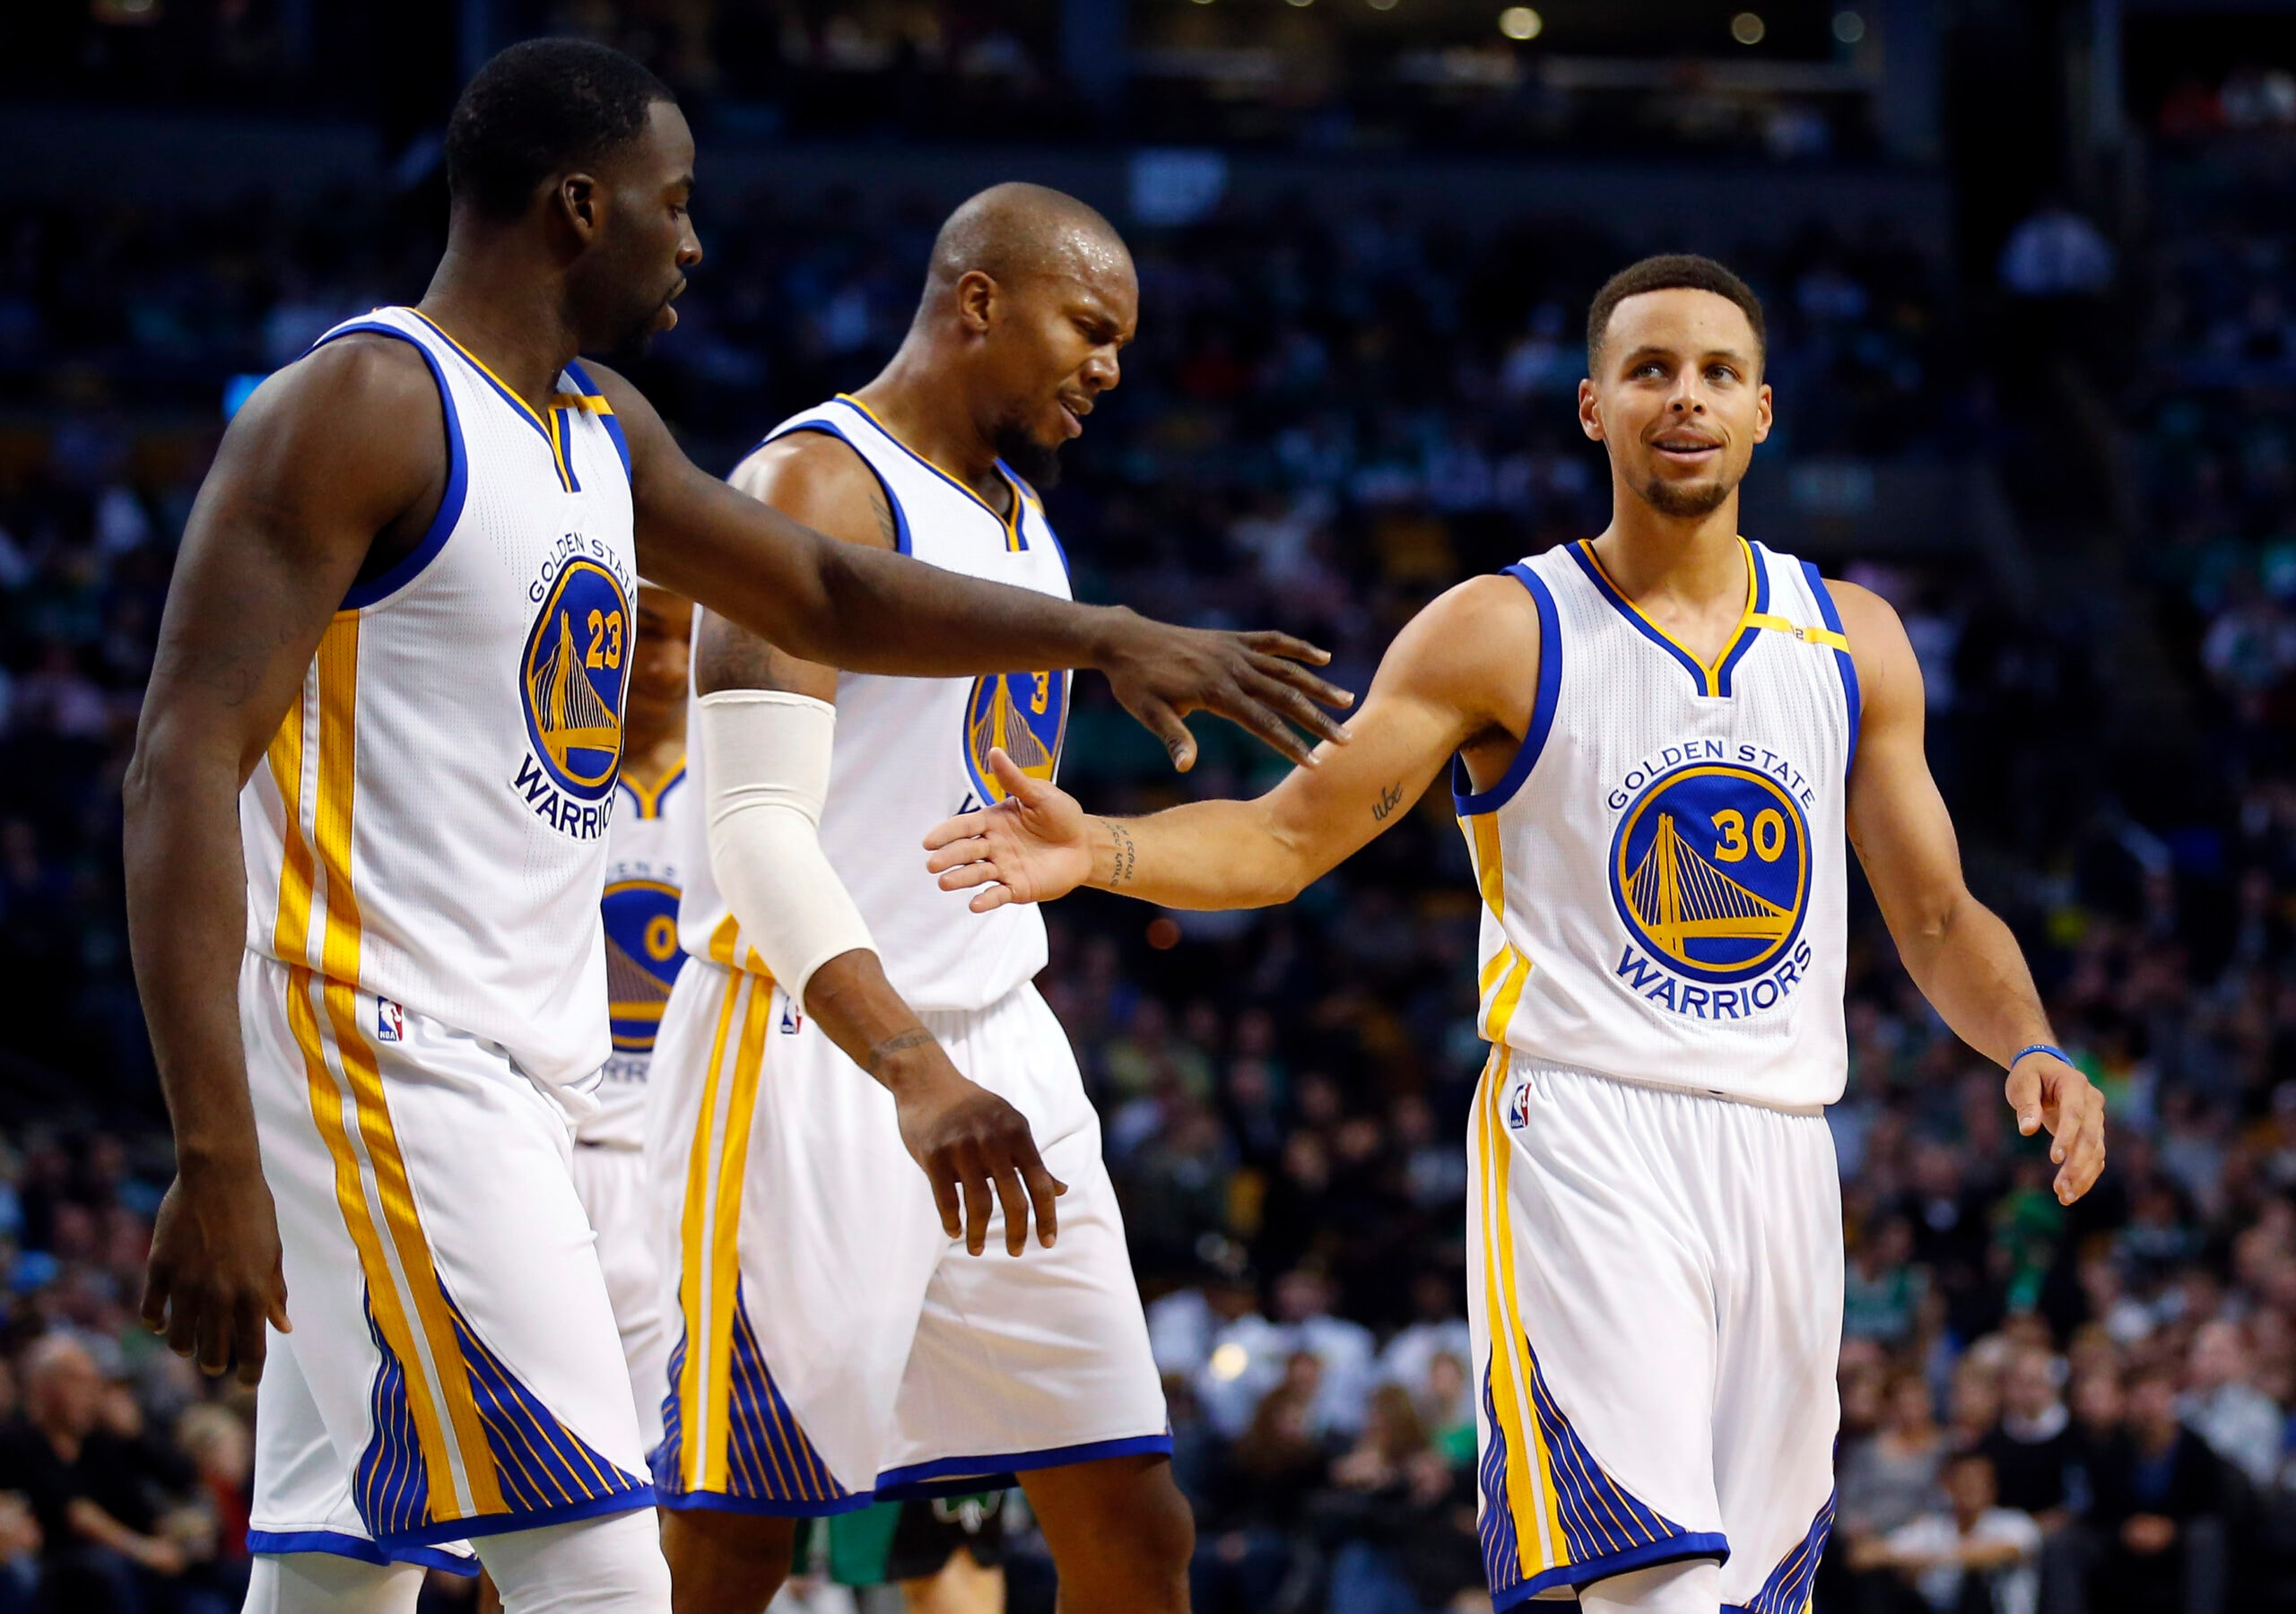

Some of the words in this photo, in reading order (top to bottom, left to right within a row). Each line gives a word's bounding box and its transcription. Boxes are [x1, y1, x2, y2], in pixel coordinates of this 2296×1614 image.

[528, 531, 585, 603] GOLDEN
[591, 539, 637, 612] STATE
[586, 609, 622, 671] 23
[1031, 670, 1050, 716] 3
[1607, 740, 1724, 811] GOLDEN
[1737, 744, 1816, 811] STATE
[1710, 807, 1787, 863] 30
[644, 914, 678, 962] 0
[1616, 938, 1813, 1020] WARRIORS
